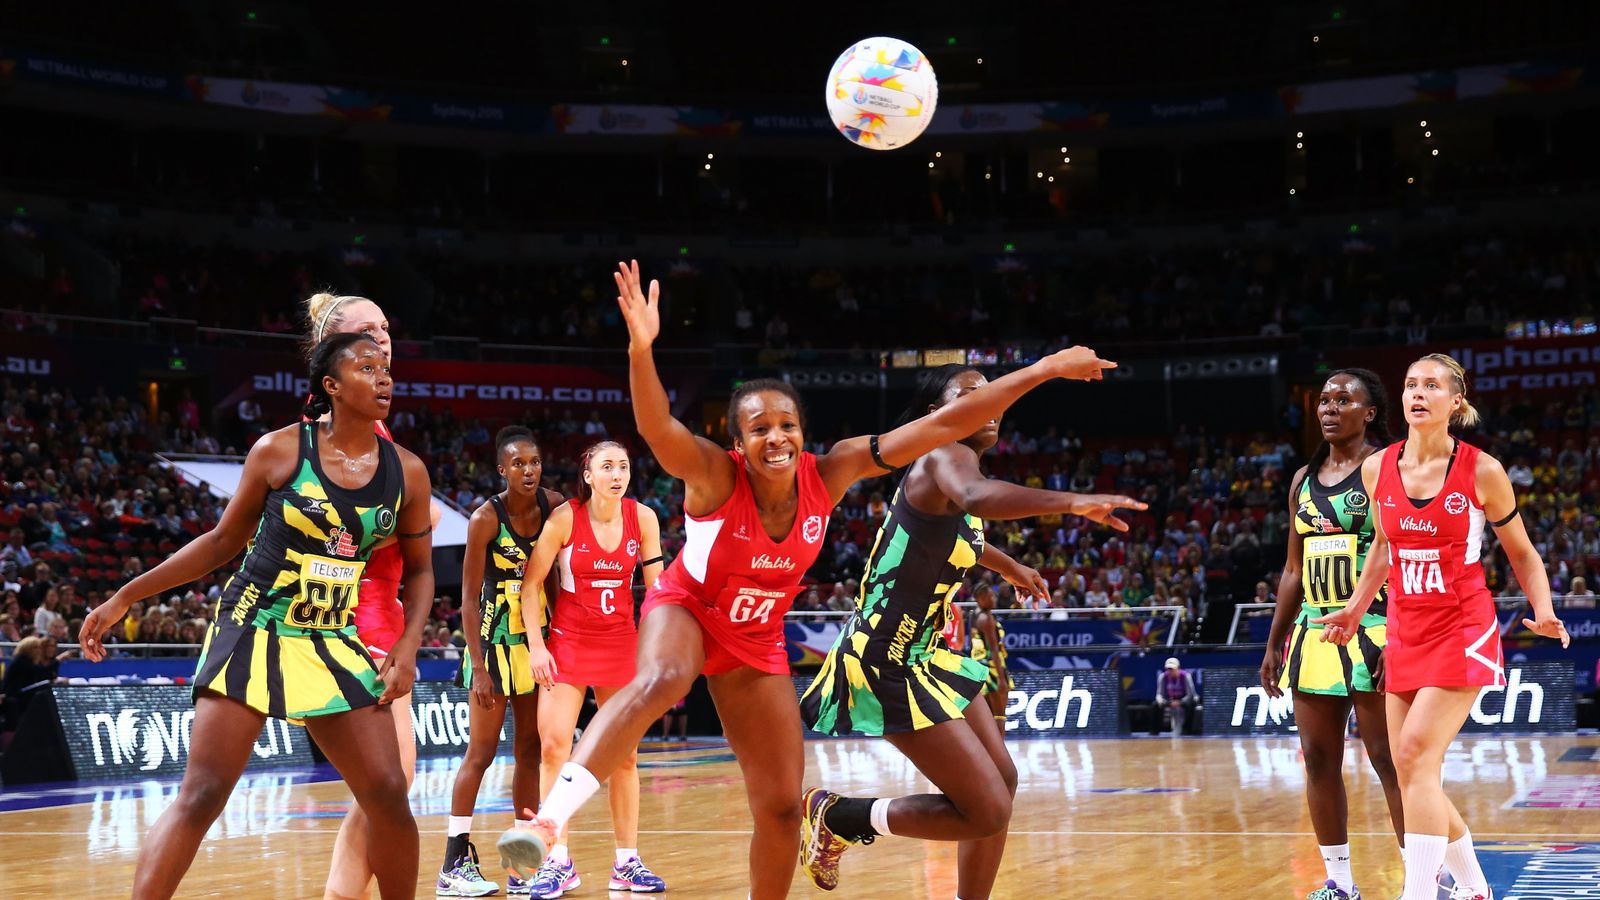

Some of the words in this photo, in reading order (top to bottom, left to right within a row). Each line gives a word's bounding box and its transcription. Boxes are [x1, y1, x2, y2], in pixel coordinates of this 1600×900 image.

[27, 57, 88, 80] NETBALL
[89, 69, 140, 87] WORLD
[141, 76, 168, 90] CUP
[869, 94, 893, 104] NETBALL
[432, 102, 477, 121] Sydney
[1451, 344, 1600, 374] llphon
[1474, 370, 1597, 393] arena
[1399, 516, 1438, 537] Vitality
[1310, 539, 1347, 552] TELSTRA
[1401, 550, 1439, 560] TELSTRA
[313, 561, 355, 579] TELSTRA
[593, 558, 624, 573] Vitality
[751, 553, 796, 573] Vitality
[1306, 554, 1355, 605] WD
[1400, 560, 1447, 595] WA
[601, 588, 616, 615] C
[729, 595, 776, 624] GA
[1003, 632, 1053, 648] ORLD
[1056, 633, 1094, 648] CUP
